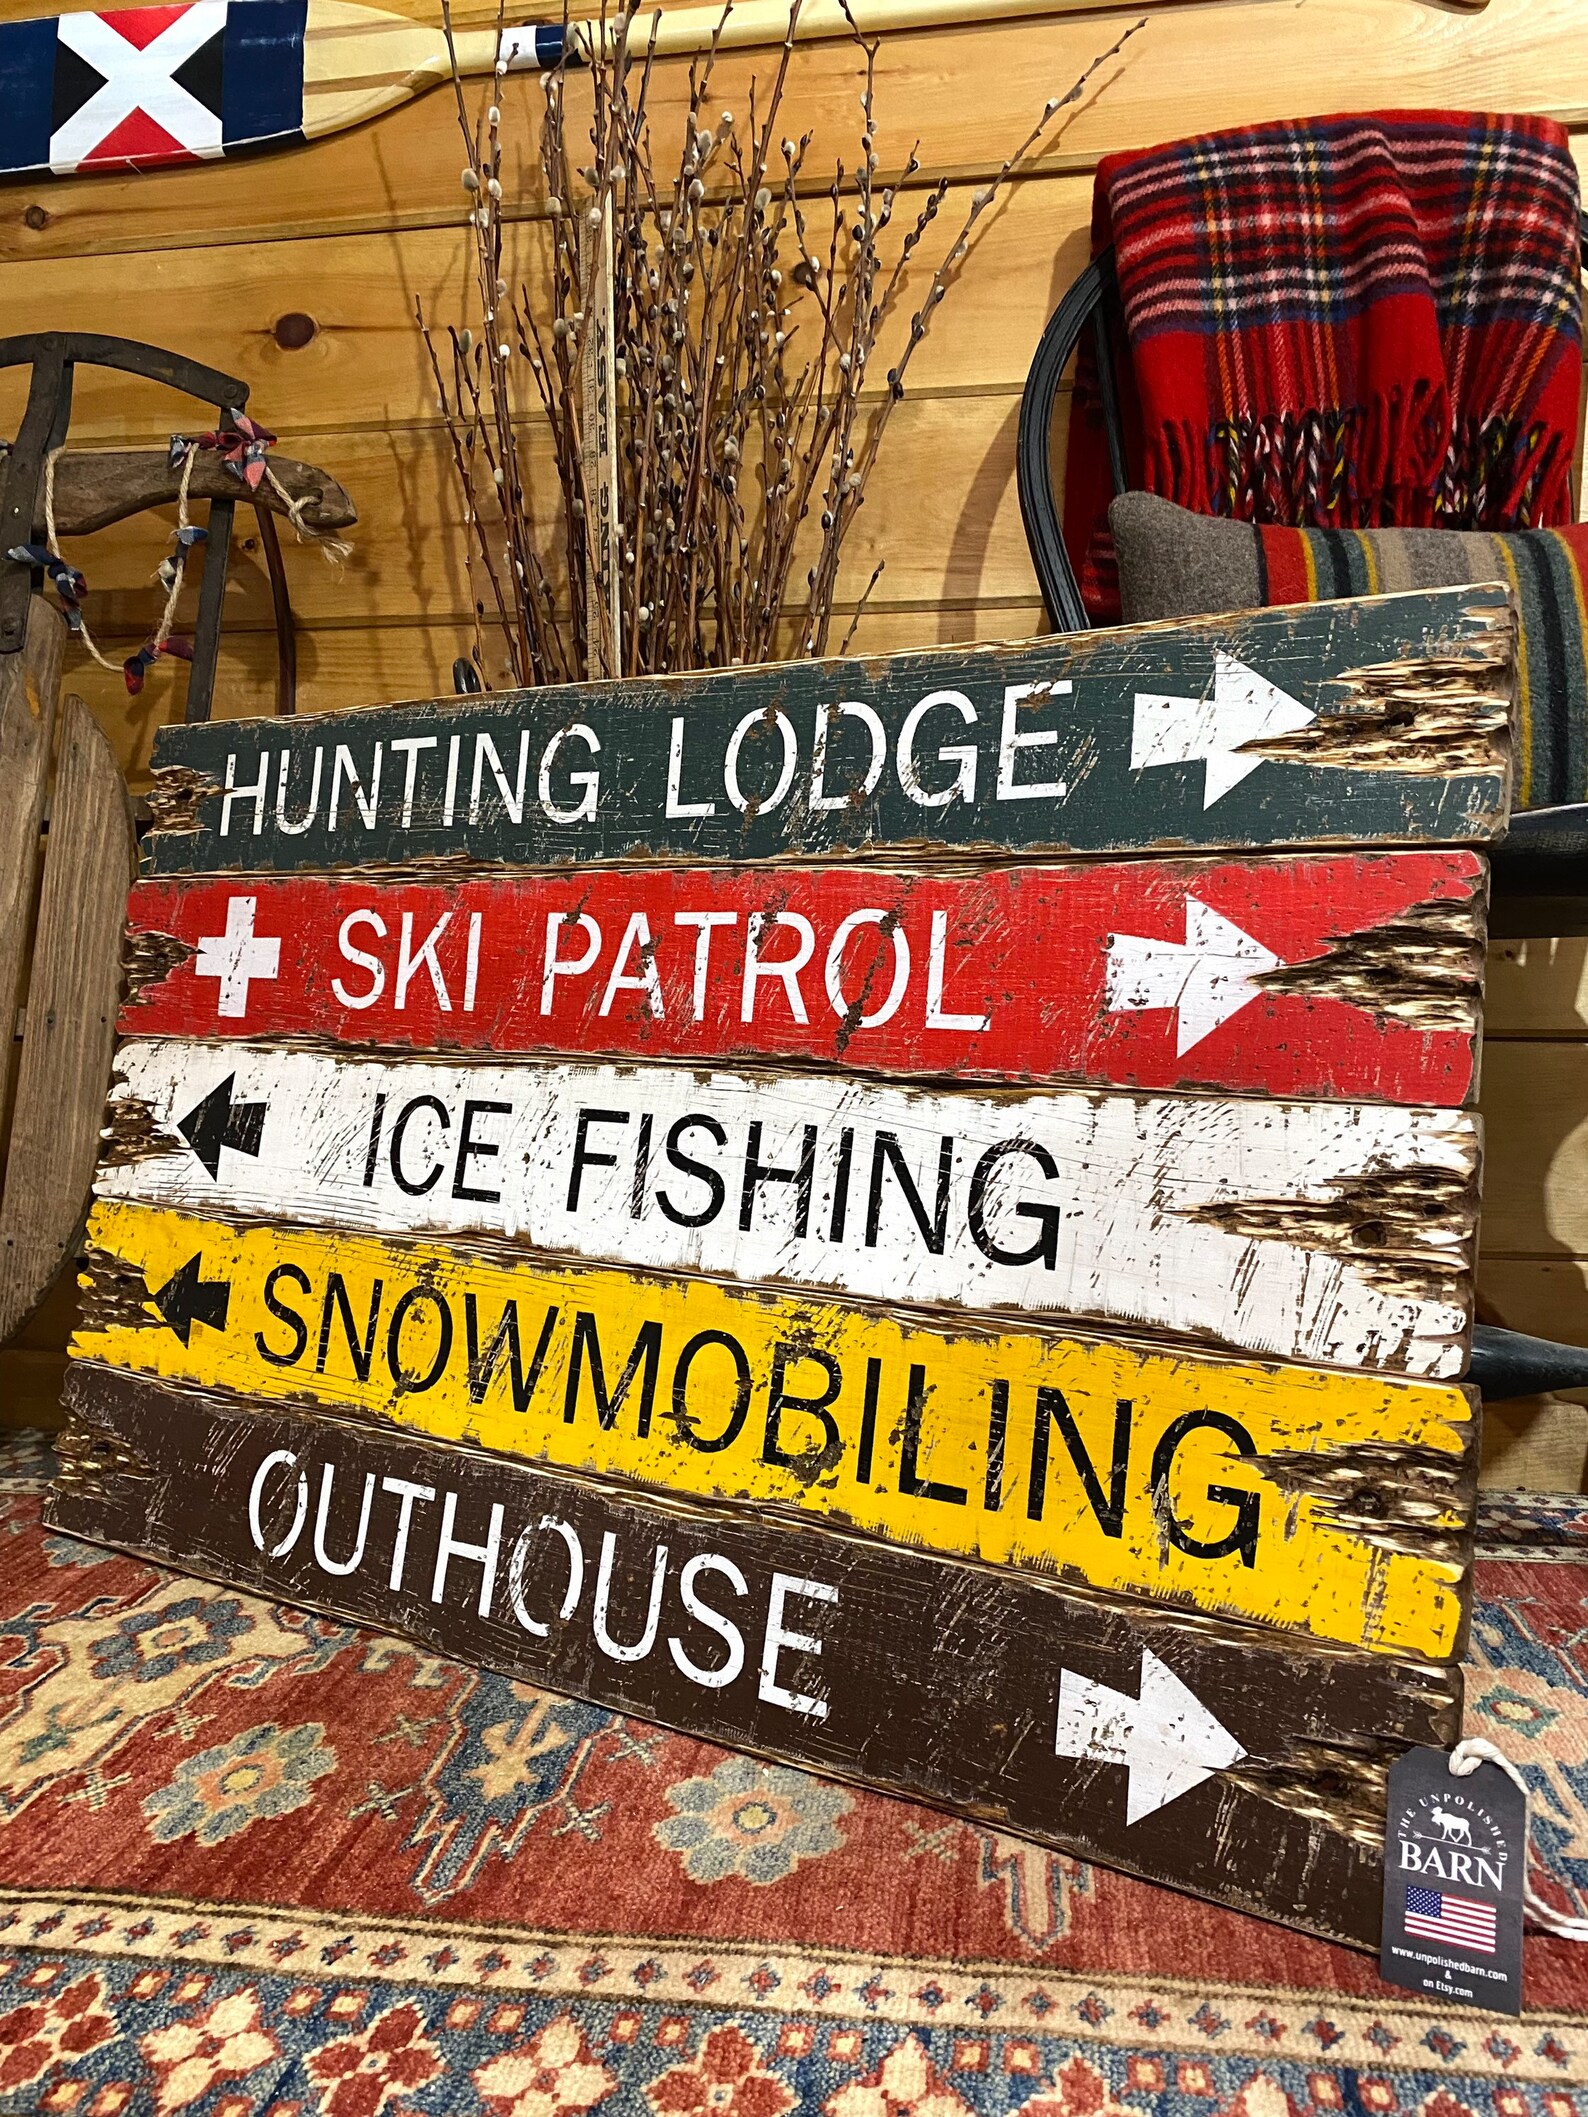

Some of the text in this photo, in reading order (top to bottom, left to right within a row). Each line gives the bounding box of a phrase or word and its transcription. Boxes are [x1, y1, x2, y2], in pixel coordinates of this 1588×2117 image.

[588, 378, 595, 395] 31
[596, 307, 608, 458] EASY.
[588, 413, 596, 430] 30
[592, 601, 600, 620] 25
[218, 679, 1073, 836] HUNTING LODGE
[331, 907, 992, 1032] SKI PATROL
[362, 1092, 1062, 1272] ICE FISHING
[254, 1262, 1262, 1570] SNOWMOBILING
[248, 1448, 840, 1719] OUTHOUSE
[1397, 1793, 1508, 1864] THE UNPOLISHED
[1398, 1840, 1507, 1892] BARN
[1391, 1945, 1508, 1983] www.unpolishedbarn.com
[1422, 1979, 1474, 1998] on Etsy.com
[1444, 1970, 1453, 1980] &
